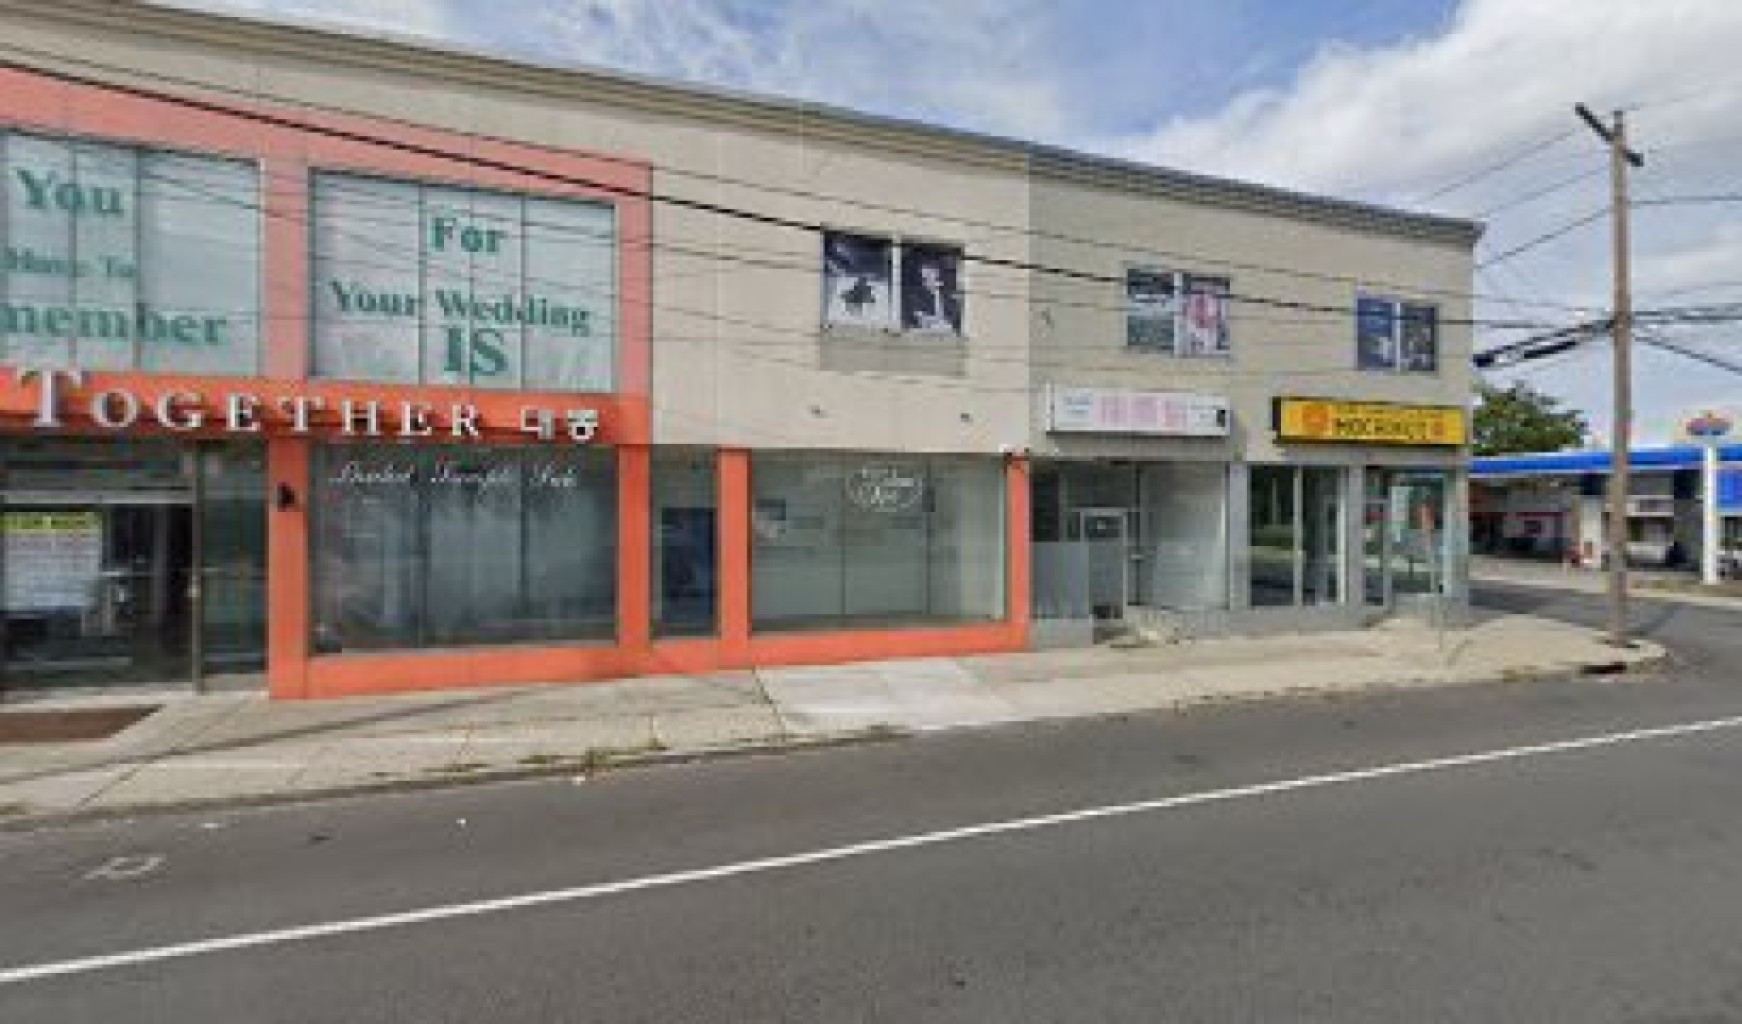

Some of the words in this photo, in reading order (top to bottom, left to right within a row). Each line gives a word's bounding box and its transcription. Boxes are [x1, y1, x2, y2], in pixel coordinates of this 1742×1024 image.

[17, 168, 123, 213] You
[431, 217, 508, 252] For
[329, 280, 417, 316] Your
[435, 289, 589, 337] Wedding
[443, 327, 509, 376] IS
[16, 367, 479, 436] TOGETHER
